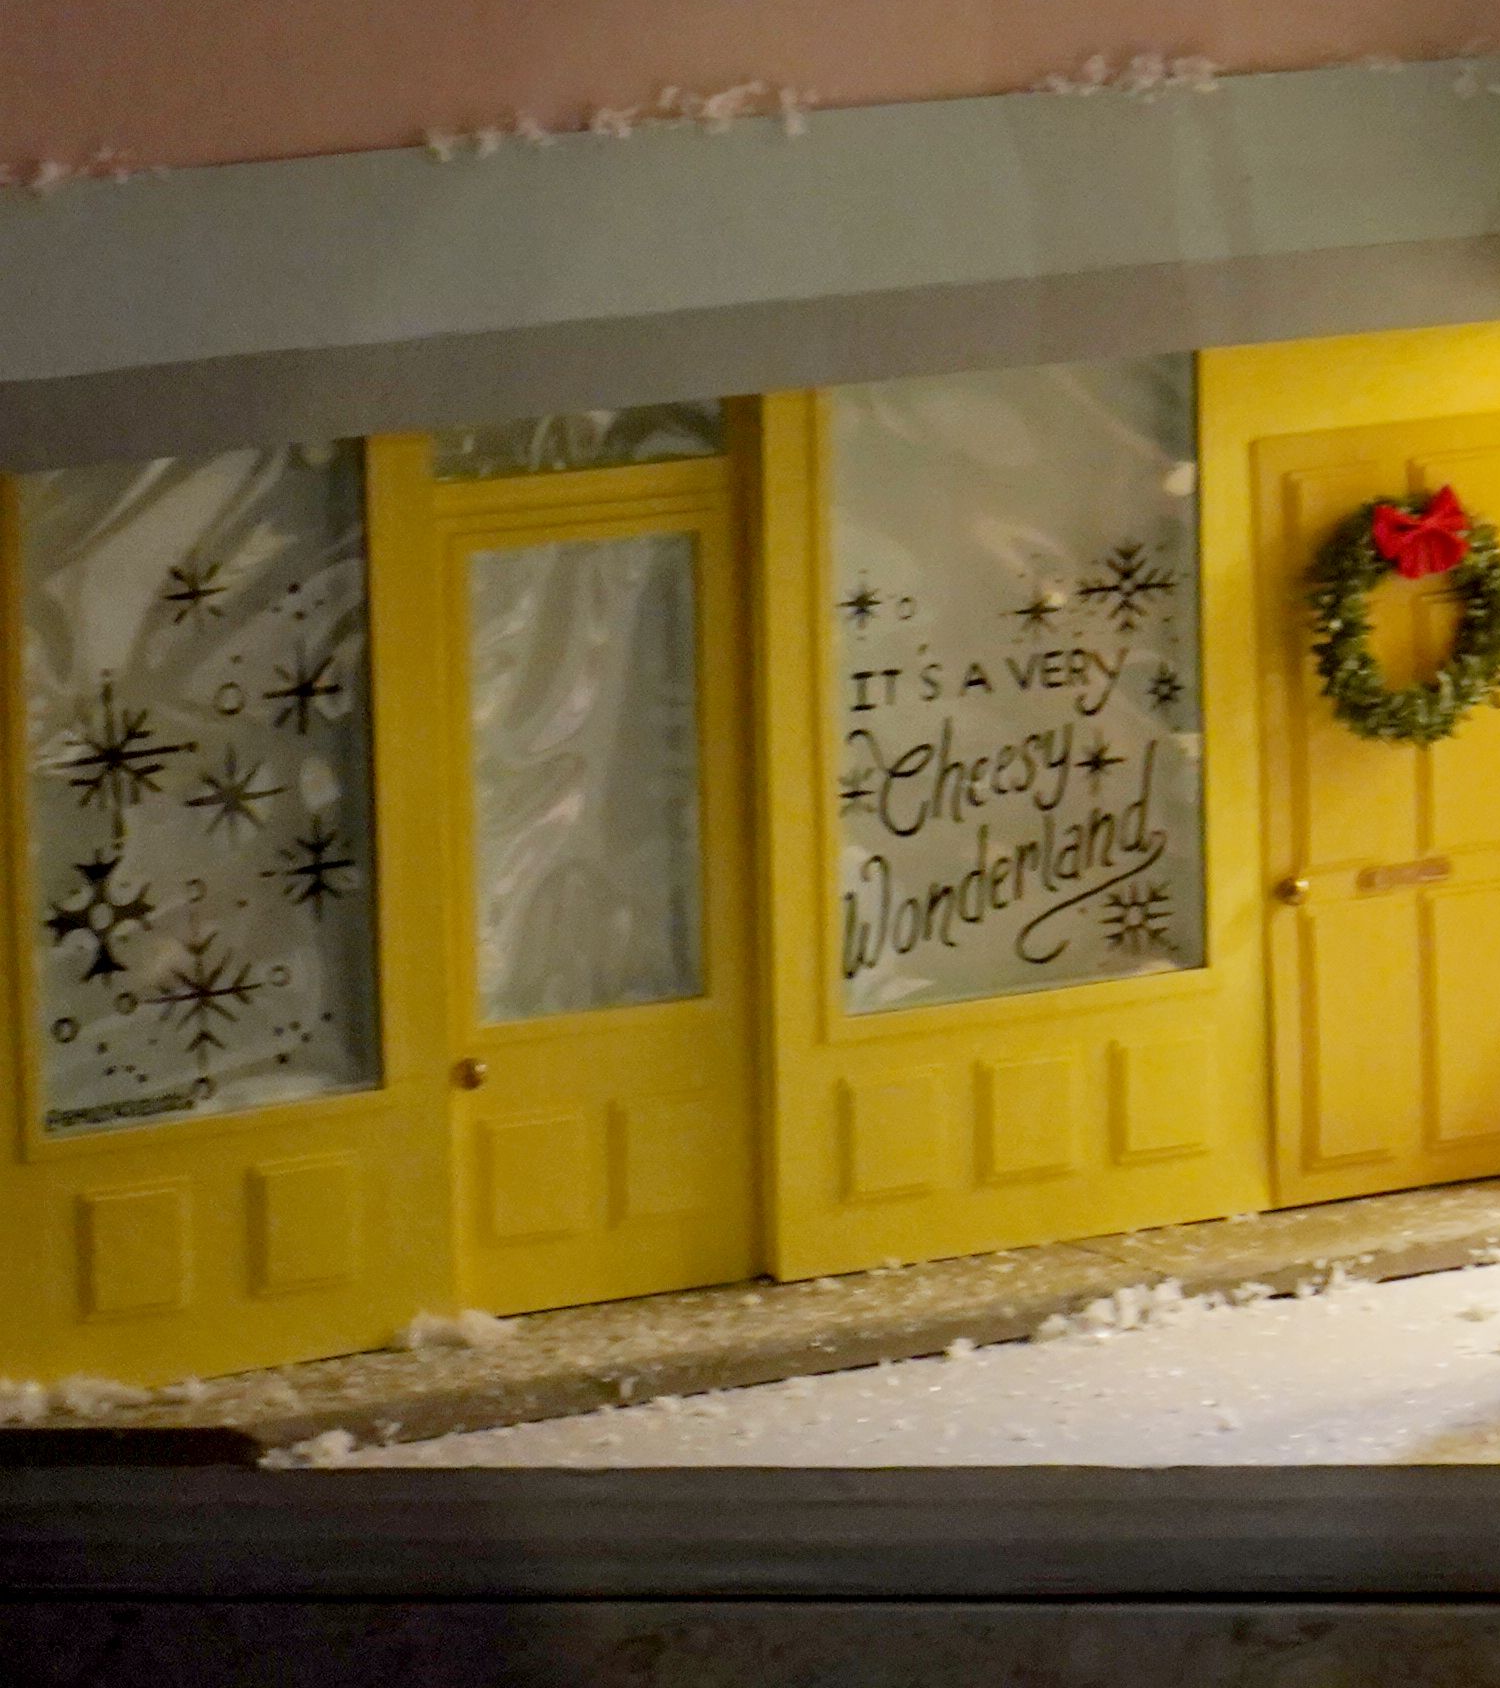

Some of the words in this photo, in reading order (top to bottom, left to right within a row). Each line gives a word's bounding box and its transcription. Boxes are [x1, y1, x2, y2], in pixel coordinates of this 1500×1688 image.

[958, 662, 994, 698] A
[1005, 647, 1130, 716] VERY
[845, 717, 1075, 837] Cheesy
[843, 740, 1167, 979] Wonderland
